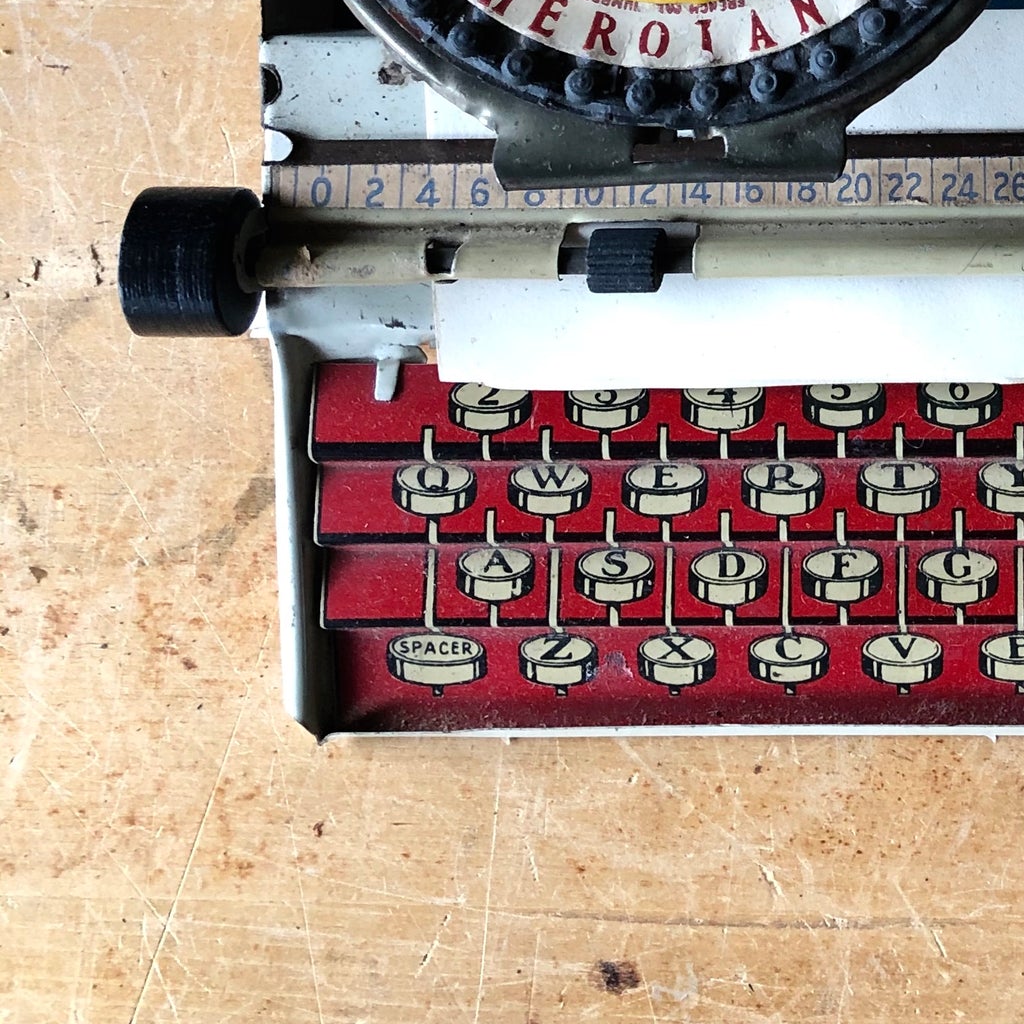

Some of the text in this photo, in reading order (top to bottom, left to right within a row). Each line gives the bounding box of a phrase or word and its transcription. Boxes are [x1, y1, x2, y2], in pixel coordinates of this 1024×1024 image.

[583, 10, 618, 56] R
[749, 9, 778, 53] A
[310, 177, 332, 207] 0
[365, 177, 385, 208] 2
[415, 177, 441, 208] 4
[470, 177, 490, 207] 6
[524, 189, 546, 207] 8
[574, 186, 604, 206] 10
[629, 185, 657, 206] 12
[681, 183, 712, 204] 14
[735, 182, 764, 204] 16
[786, 182, 817, 203] 18
[836, 172, 872, 203] 20
[888, 172, 923, 202] 22
[941, 172, 979, 202] 24
[477, 382, 500, 406] 2
[416, 465, 450, 492] Q
[529, 464, 575, 489] W
[652, 465, 679, 489] E
[766, 464, 803, 489] R
[880, 463, 915, 488] T
[483, 549, 513, 574] A
[601, 551, 628, 577] S
[718, 553, 745, 578] D
[832, 552, 858, 578] F
[943, 550, 972, 578] G
[399, 640, 474, 656] SPACER
[540, 637, 574, 661] Z
[656, 637, 696, 661] X
[775, 636, 802, 661] C
[887, 636, 917, 659] V
